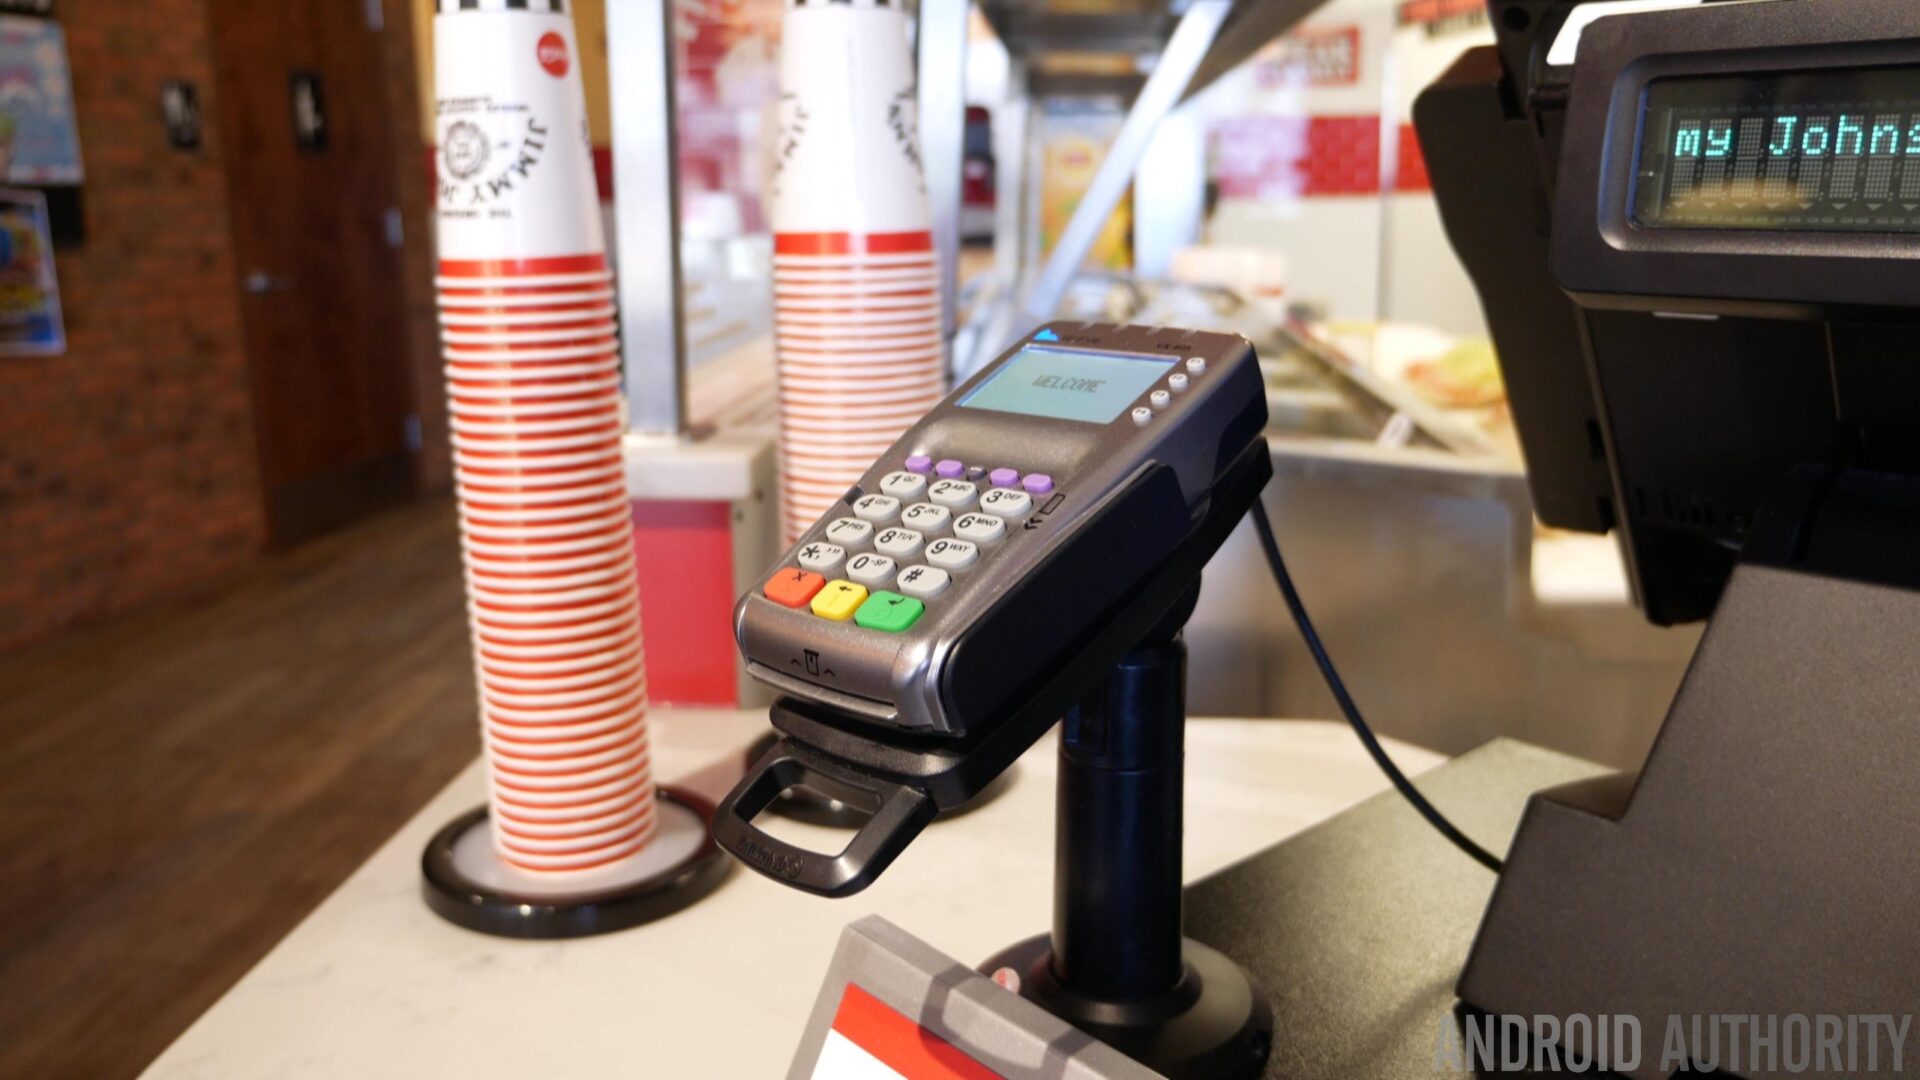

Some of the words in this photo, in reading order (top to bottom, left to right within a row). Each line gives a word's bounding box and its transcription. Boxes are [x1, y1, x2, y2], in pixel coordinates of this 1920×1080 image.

[1674, 128, 1732, 158] my
[471, 117, 549, 204] JIMMY
[1031, 373, 1107, 394] WELCOME
[889, 474, 903, 486] 1
[934, 481, 952, 495] 2
[951, 483, 971, 492] ABC
[859, 497, 876, 509] 4
[986, 490, 1003, 504] 3
[1003, 493, 1024, 501] DEF
[907, 505, 924, 518] 5
[832, 520, 850, 533] 7
[958, 515, 976, 529] 6
[975, 518, 999, 528] MNO
[879, 529, 897, 544] 8
[897, 532, 917, 542] TUV
[930, 540, 949, 555] 9
[948, 543, 971, 552] WXY
[853, 555, 870, 570] 0
